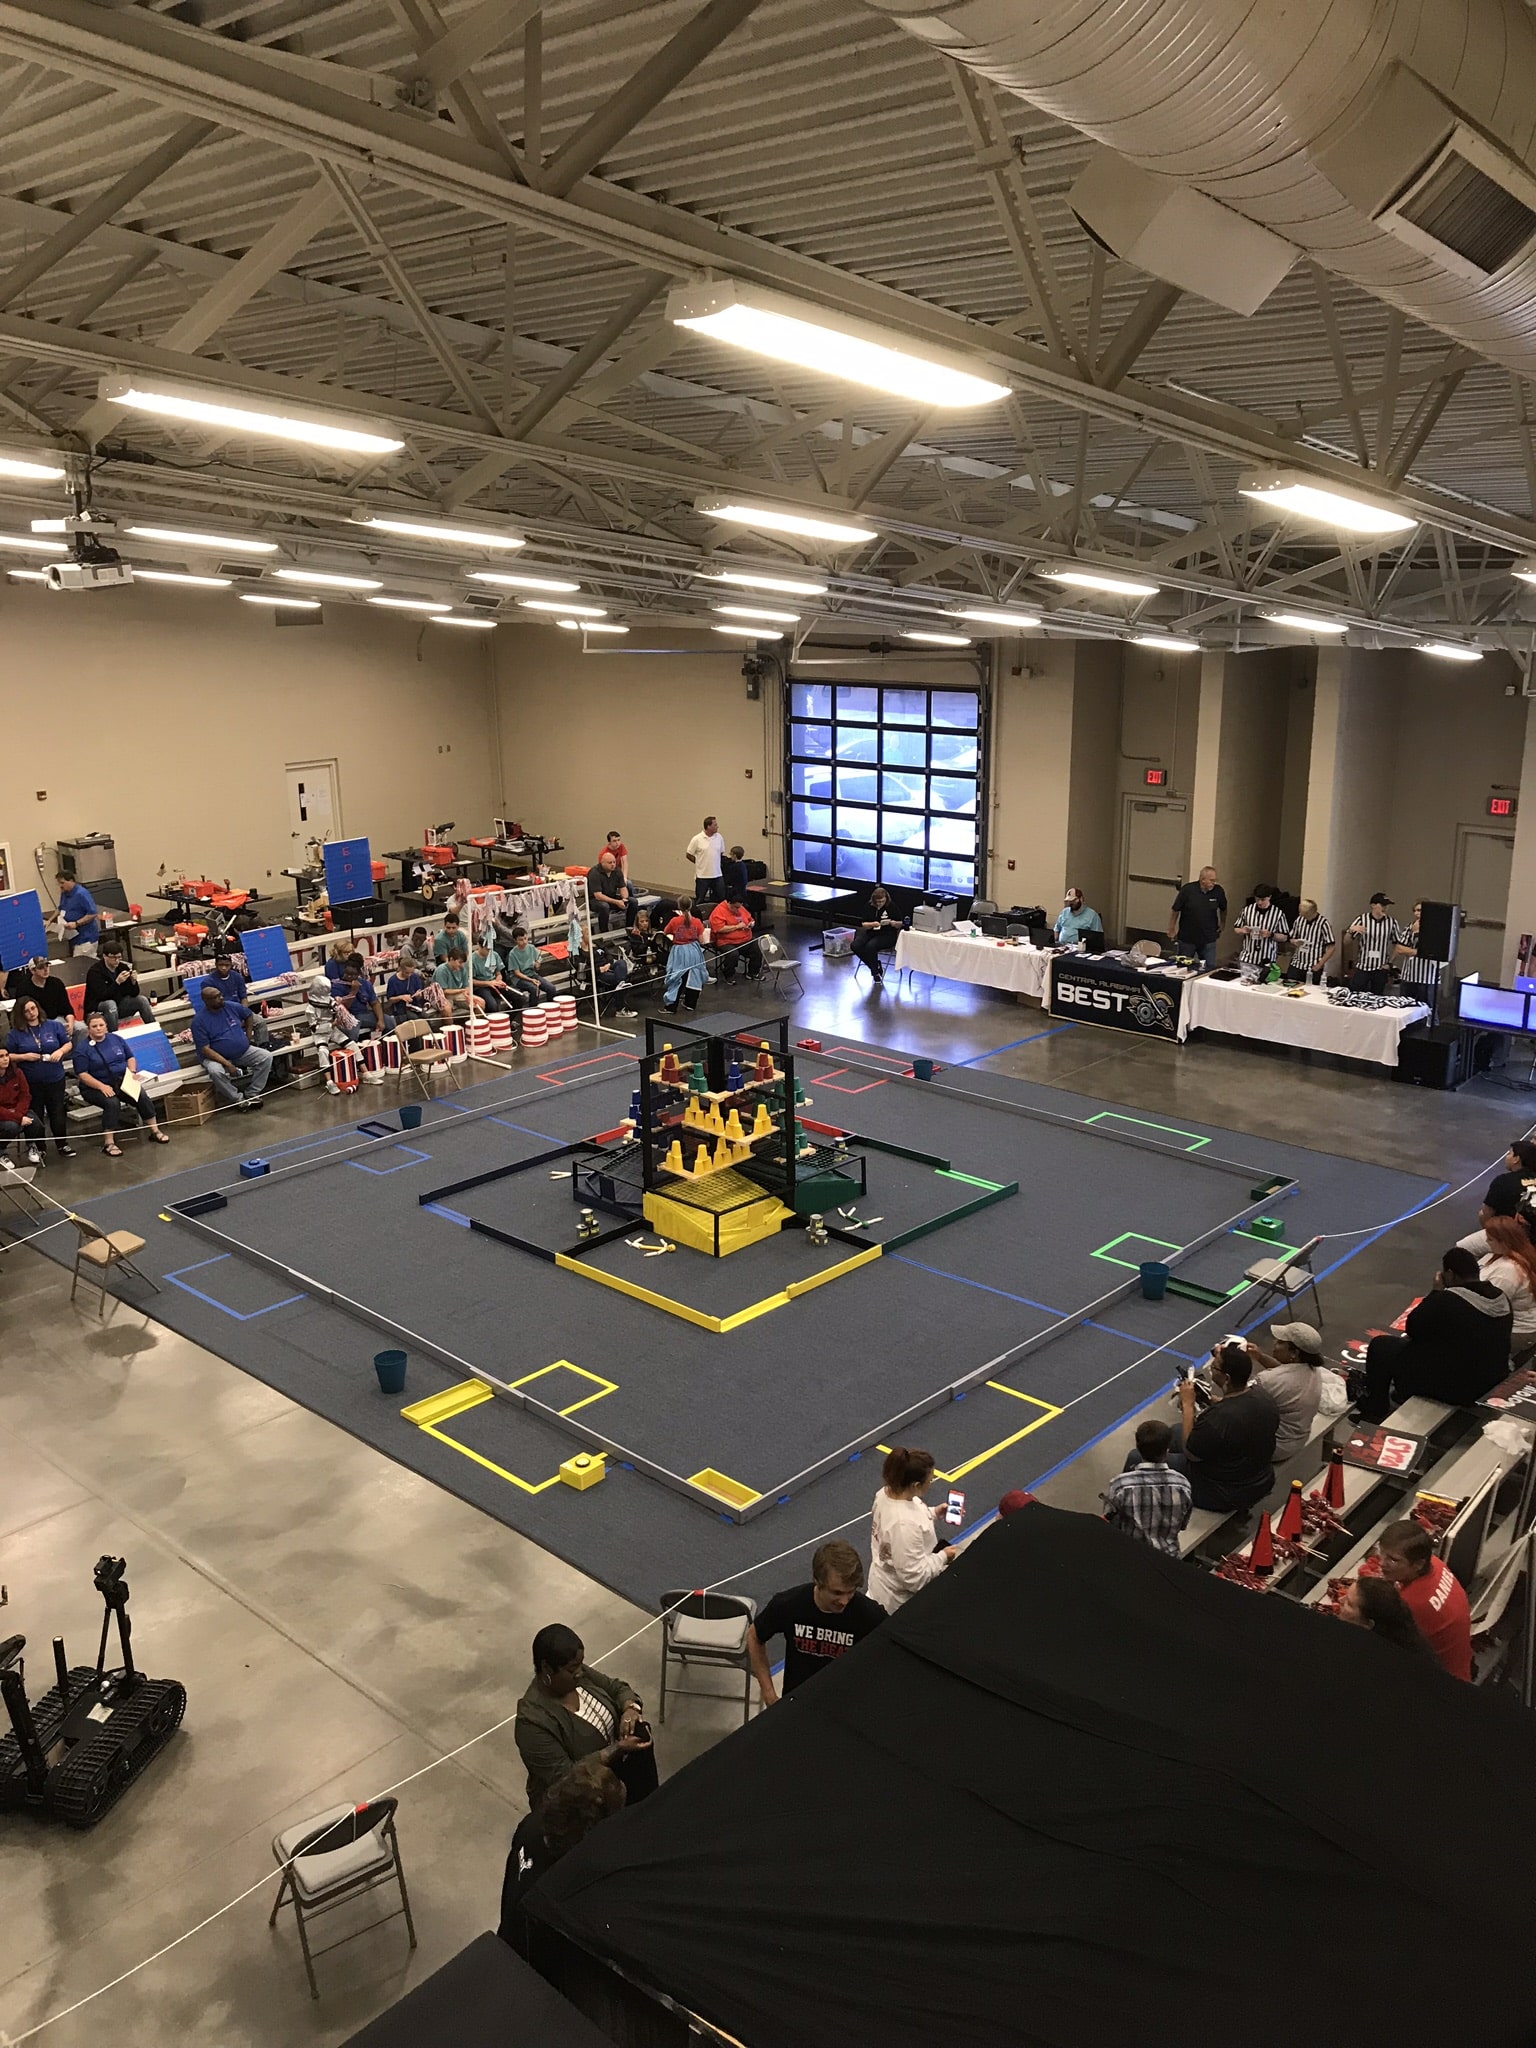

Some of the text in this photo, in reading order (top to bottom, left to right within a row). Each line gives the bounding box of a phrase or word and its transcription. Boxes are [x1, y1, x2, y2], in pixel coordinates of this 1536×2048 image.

[1147, 770, 1162, 784] EXIT
[1491, 799, 1510, 815] EXIT
[1058, 972, 1141, 994] CENTRAL ALABAMA
[1057, 982, 1129, 1012] BEST
[794, 1623, 854, 1646] WE BRING
